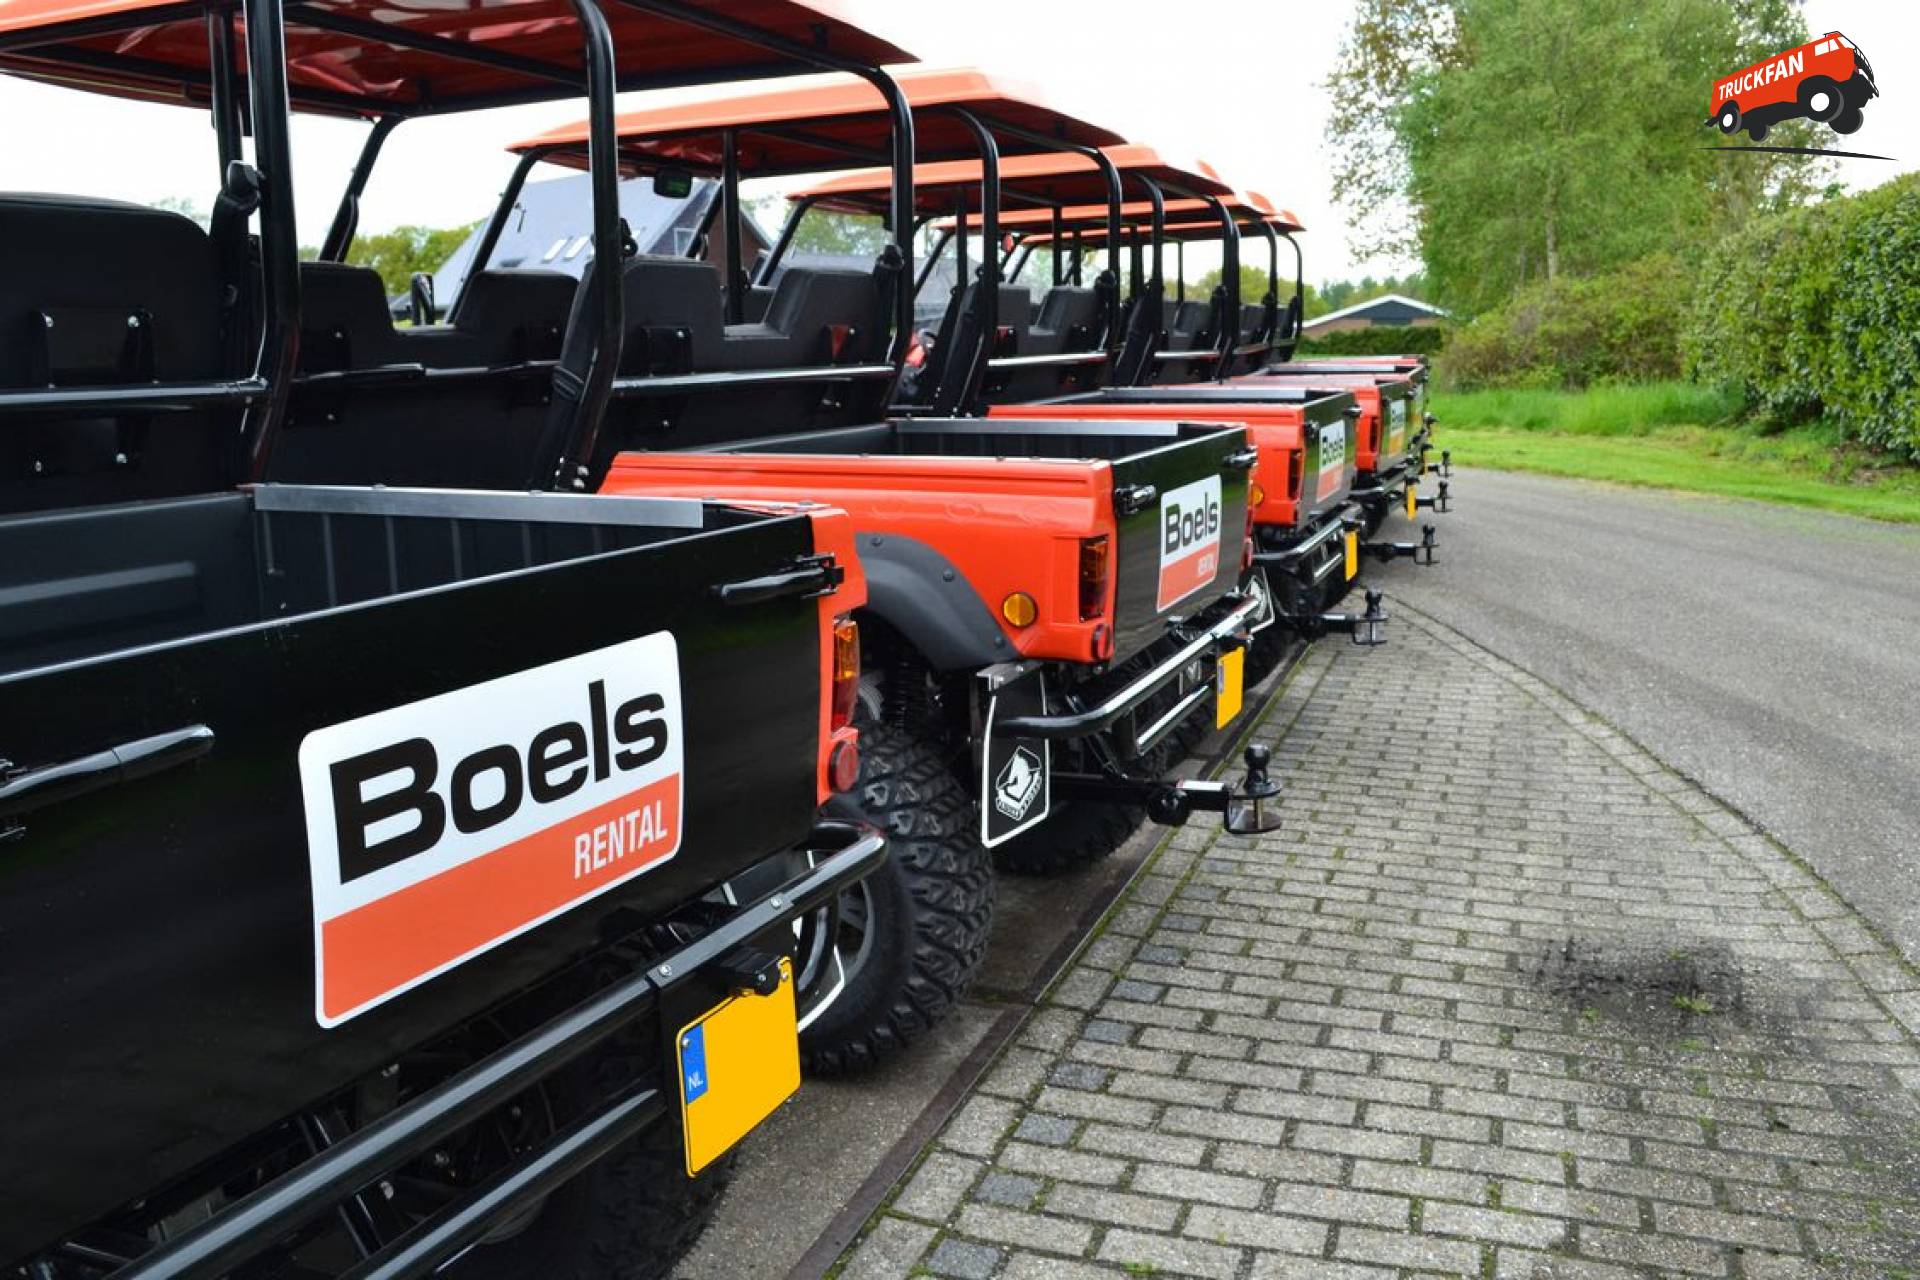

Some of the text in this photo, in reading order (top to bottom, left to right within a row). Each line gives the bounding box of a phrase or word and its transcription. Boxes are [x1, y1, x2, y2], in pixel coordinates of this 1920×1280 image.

[1165, 491, 1218, 555] Boels
[329, 679, 668, 884] Boels
[574, 800, 668, 880] RENTAL
[688, 1071, 704, 1092] NL
